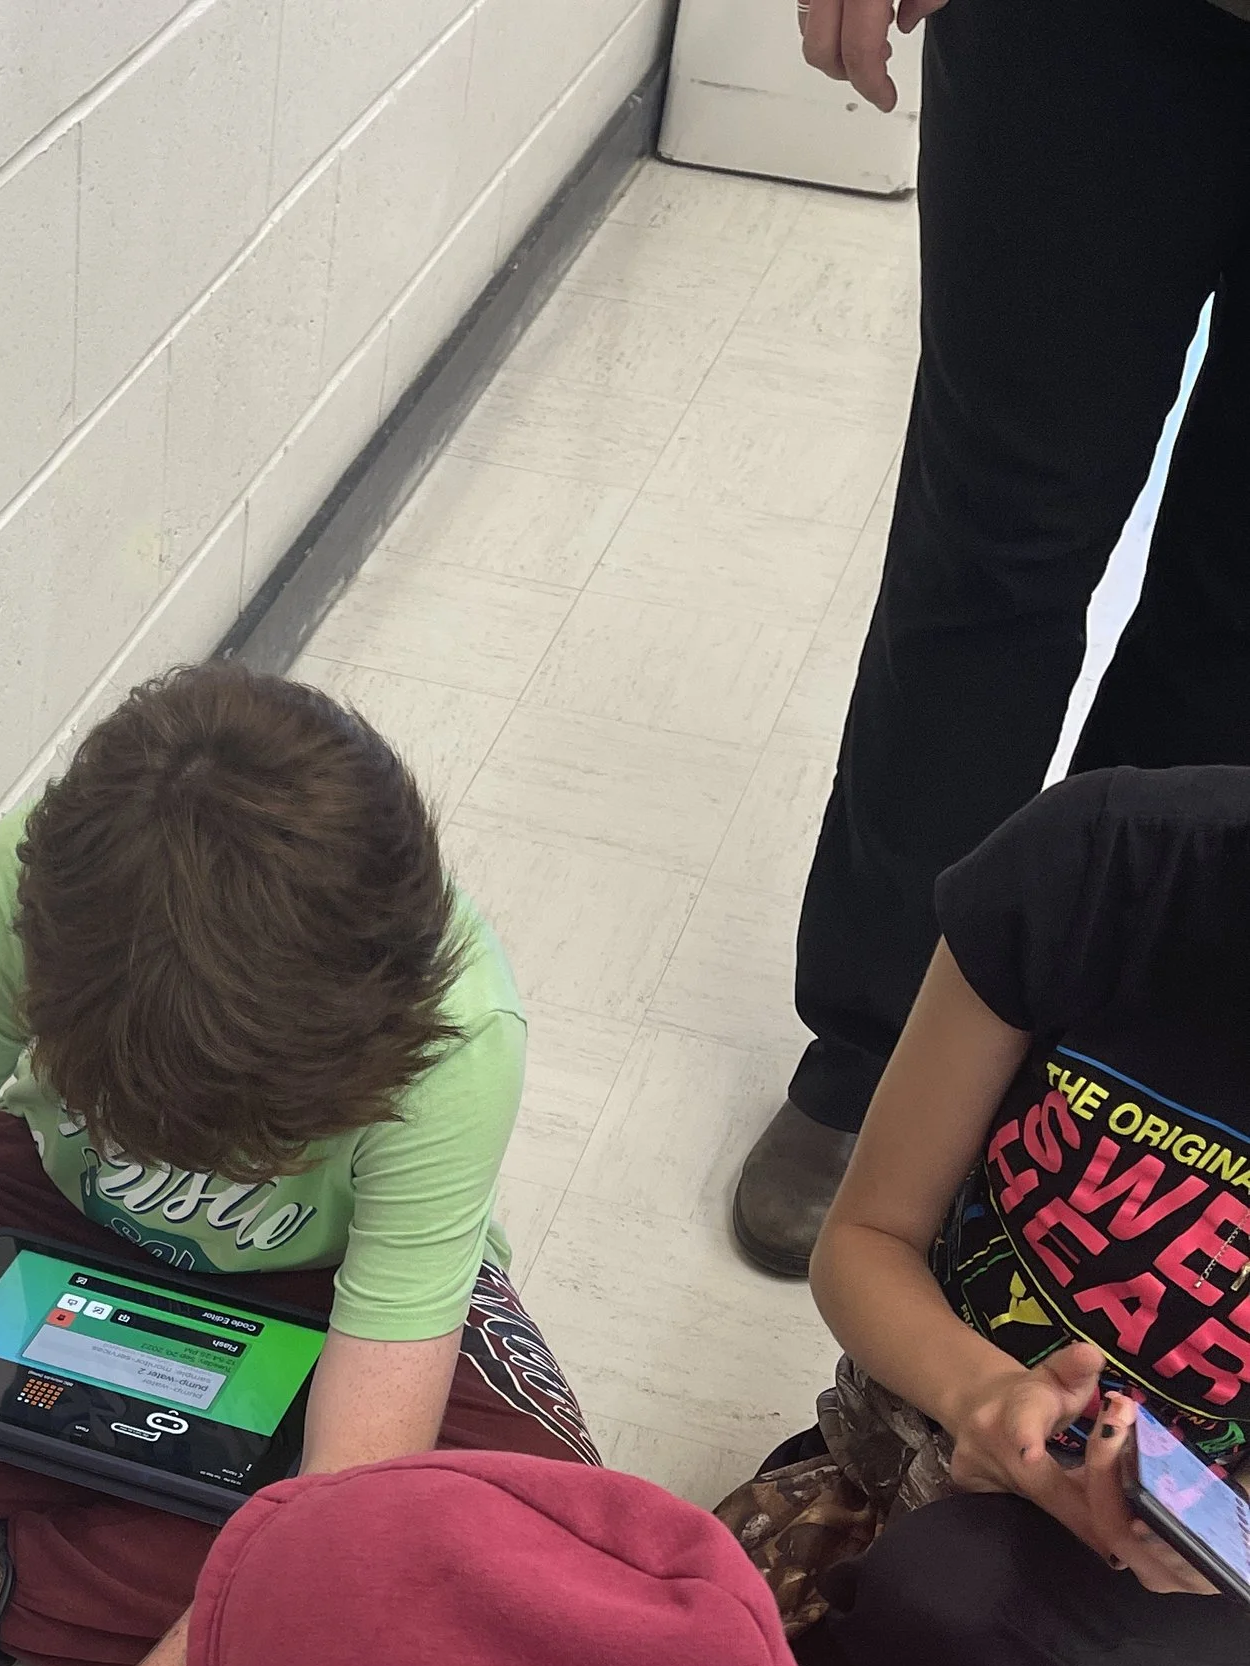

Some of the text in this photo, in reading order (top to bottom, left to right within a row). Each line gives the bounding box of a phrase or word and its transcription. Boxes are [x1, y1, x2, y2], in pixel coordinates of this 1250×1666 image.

[1046, 1062, 1110, 1121] THE
[202, 1311, 257, 1332] Code Editor
[212, 1339, 239, 1353] Flash
[92, 1346, 173, 1373] monitor-services
[137, 1367, 209, 1392] pump-water 2
[142, 1378, 203, 1400] pump-water
